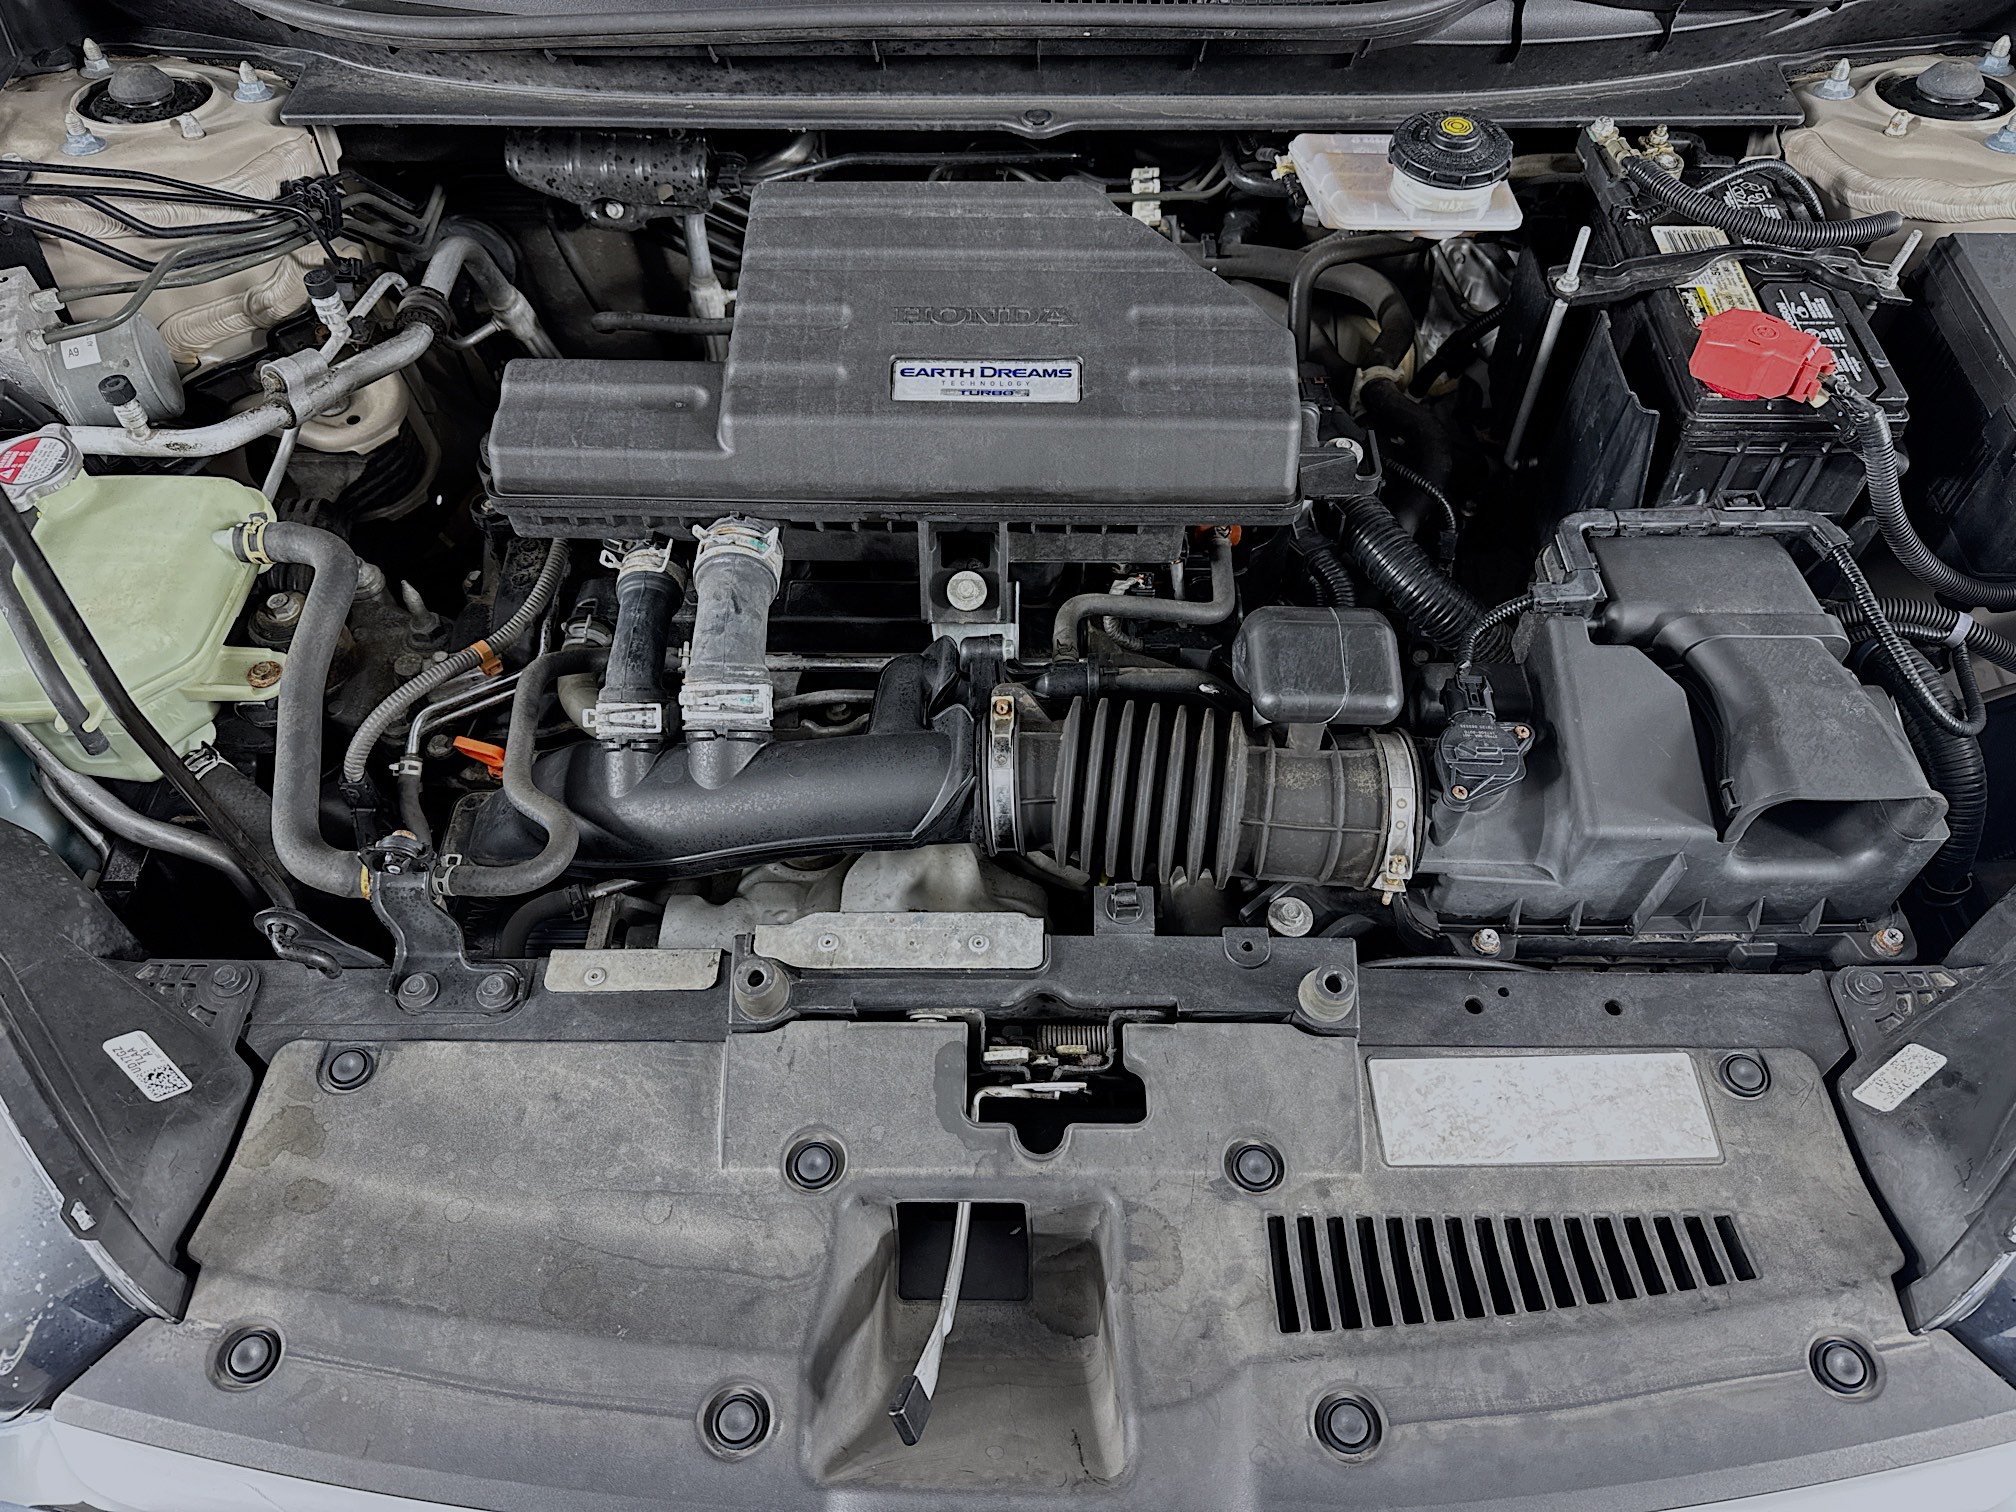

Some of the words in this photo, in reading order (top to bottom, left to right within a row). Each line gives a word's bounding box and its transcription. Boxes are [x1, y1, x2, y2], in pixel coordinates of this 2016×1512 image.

[891, 305, 1081, 327] HONDA
[69, 347, 79, 358] A9
[900, 366, 975, 378] EARTH
[980, 366, 1073, 379] DREAMS
